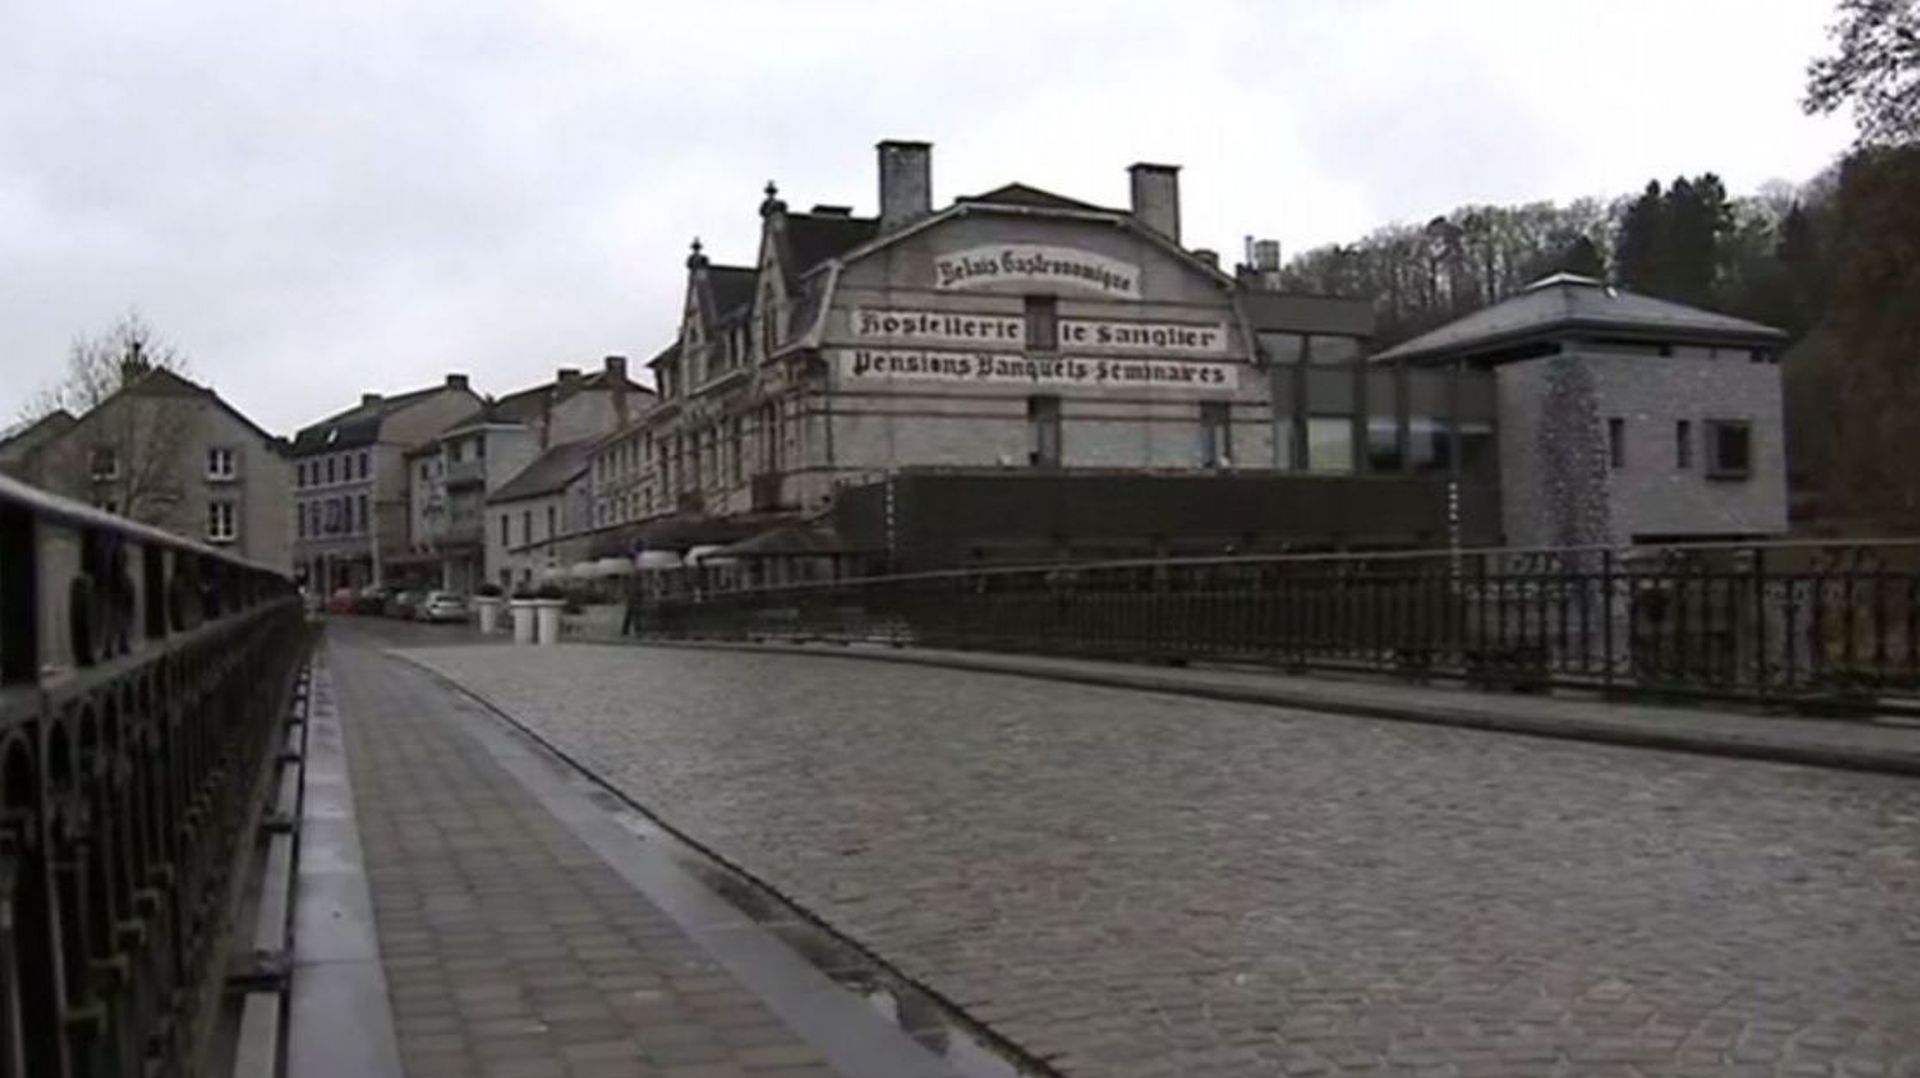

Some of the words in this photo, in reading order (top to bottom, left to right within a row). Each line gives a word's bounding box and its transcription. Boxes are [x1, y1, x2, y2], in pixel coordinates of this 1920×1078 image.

[1001, 251, 1130, 289] Gastronomique
[861, 313, 1019, 338] Hostellerie
[1097, 326, 1216, 347] Sanglier
[853, 352, 972, 375] Pensions
[976, 354, 1088, 382] Banquets
